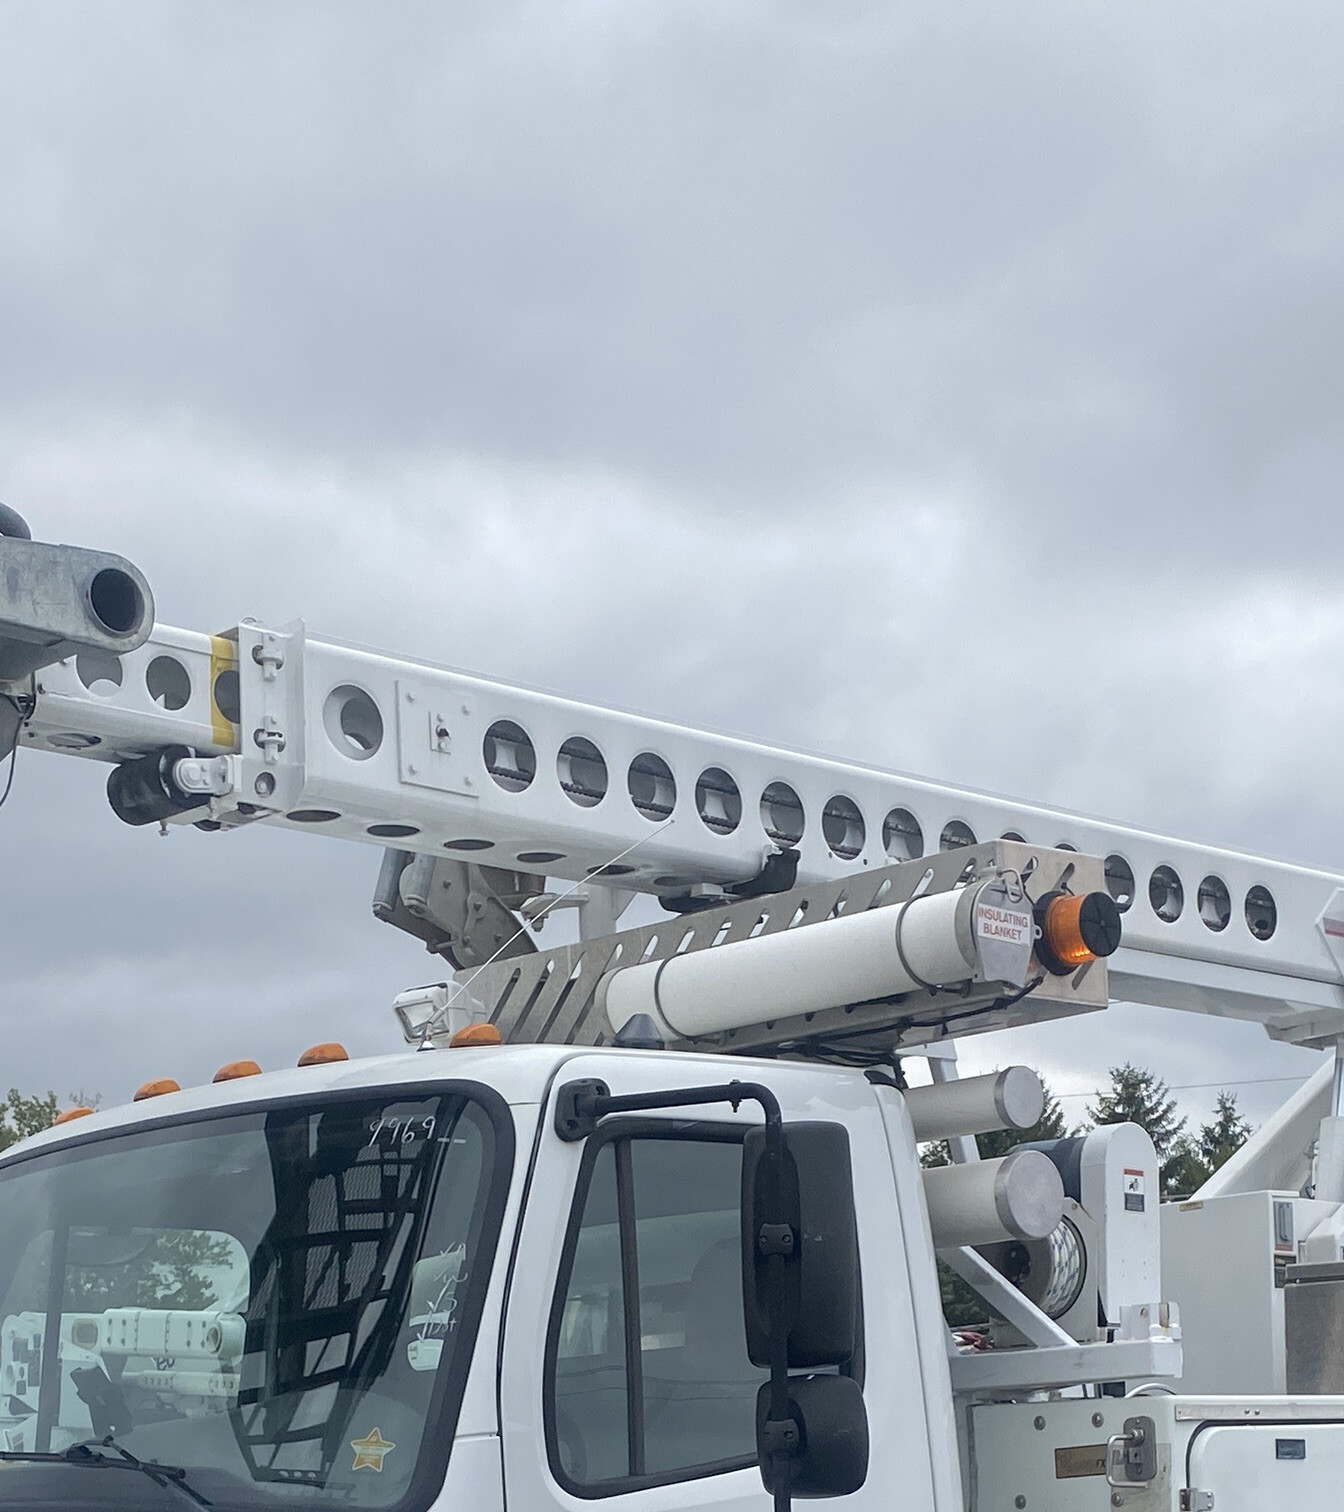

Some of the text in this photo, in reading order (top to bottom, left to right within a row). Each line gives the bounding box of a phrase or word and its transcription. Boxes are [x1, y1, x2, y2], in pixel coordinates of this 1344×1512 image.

[978, 907, 1028, 928] INSULATING
[983, 922, 1022, 941] BLANKET
[369, 1115, 436, 1148] 9969
